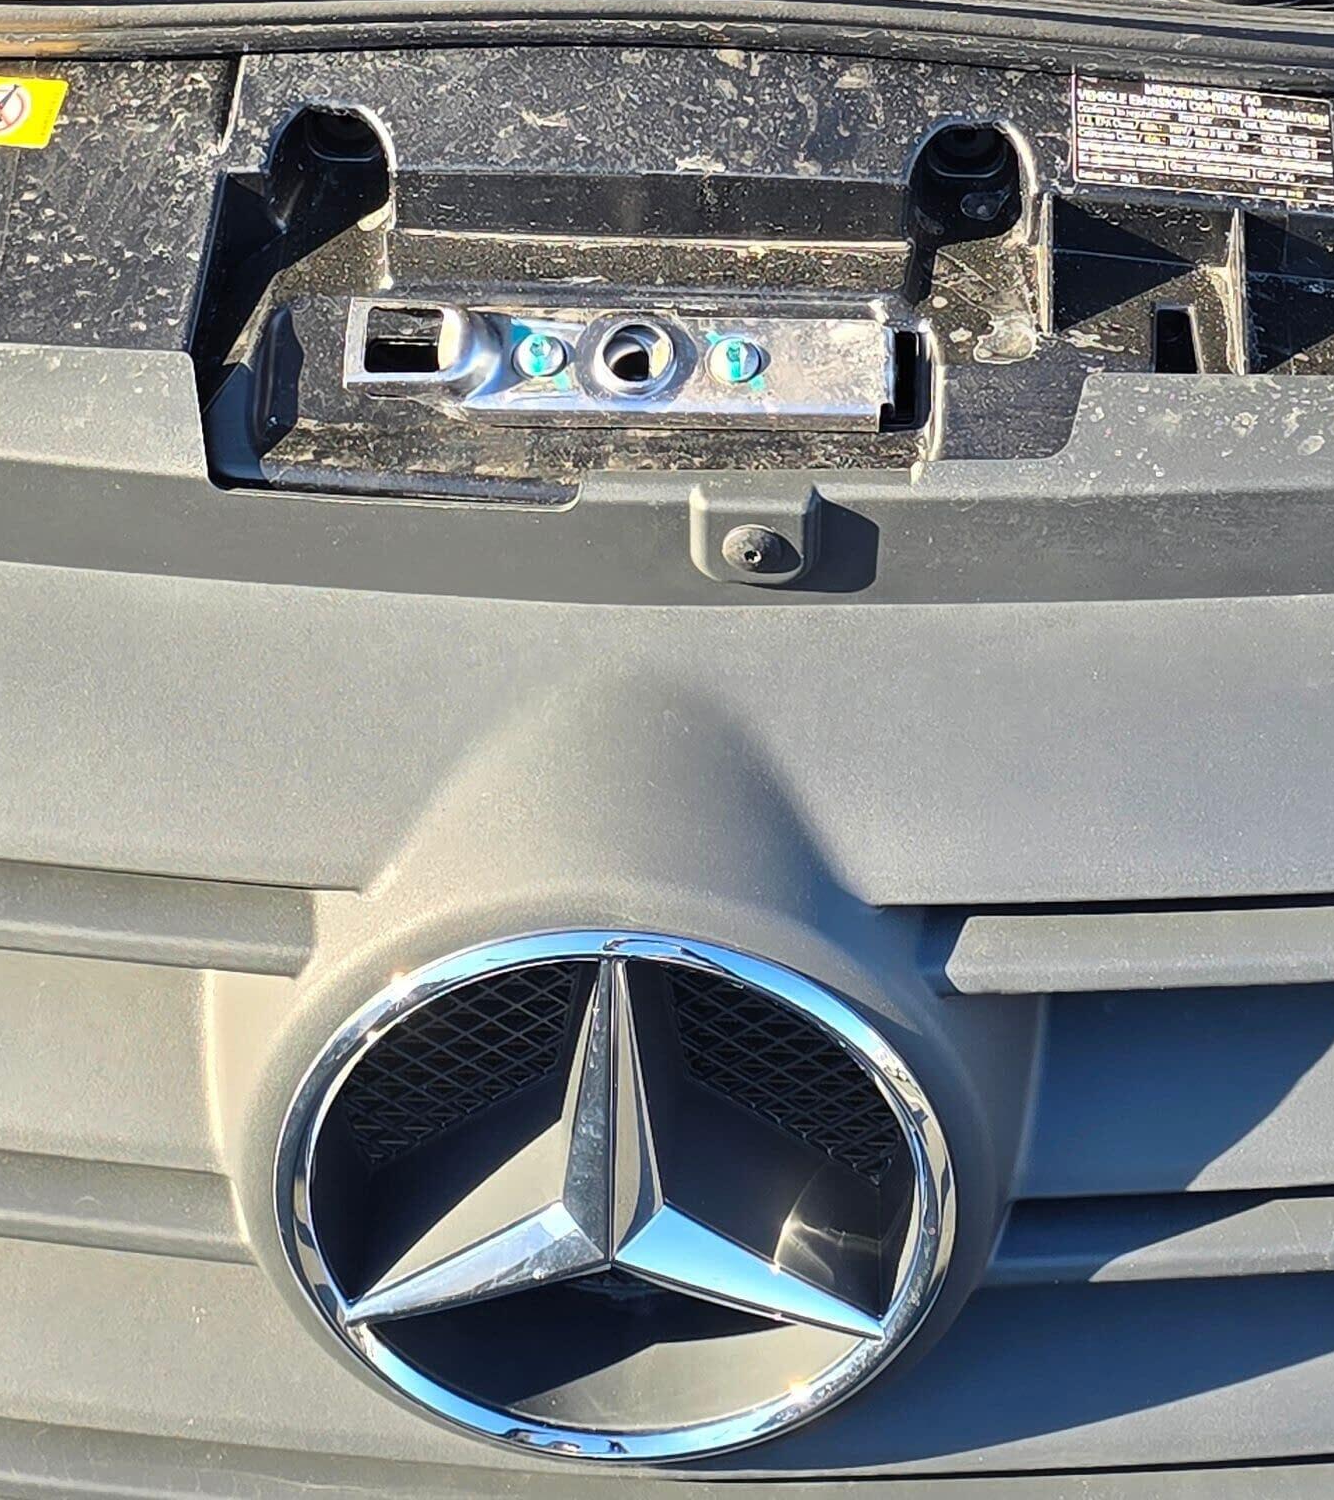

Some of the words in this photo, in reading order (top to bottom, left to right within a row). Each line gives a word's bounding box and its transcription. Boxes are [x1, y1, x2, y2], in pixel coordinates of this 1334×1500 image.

[1077, 88, 1127, 105] VEHICLE
[1128, 93, 1187, 111] EMISSION
[1188, 99, 1247, 118] CONTROL
[1247, 105, 1329, 126] INFORMATION
[1144, 83, 1242, 105] MERCEDES-BENZ
[1244, 95, 1262, 107] AG
